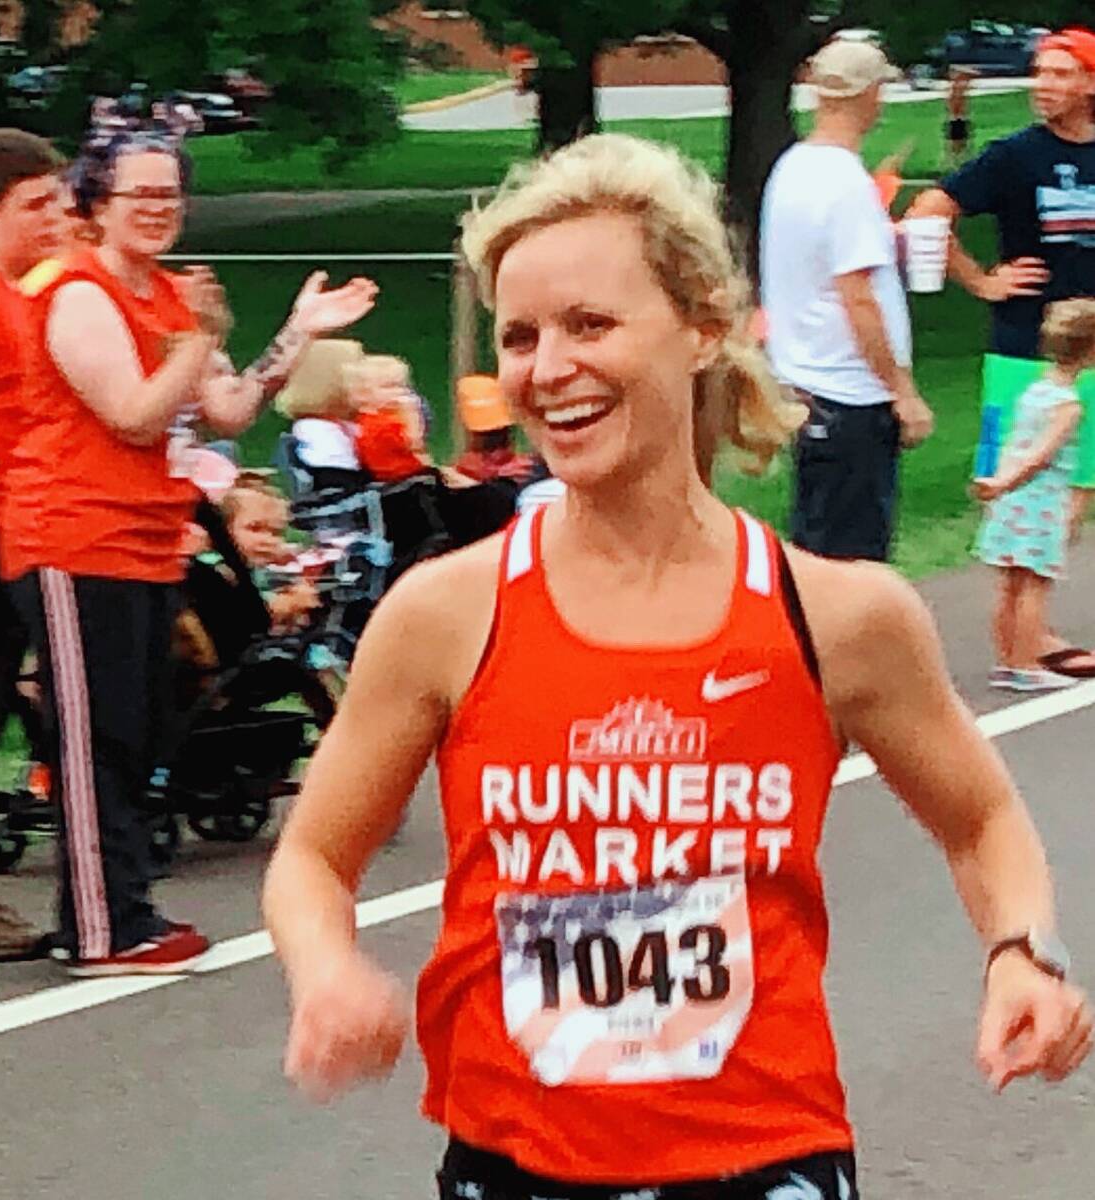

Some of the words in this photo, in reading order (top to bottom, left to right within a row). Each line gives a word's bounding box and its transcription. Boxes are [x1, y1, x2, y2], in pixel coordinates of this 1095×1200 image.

[482, 763, 793, 822] RUNNERS
[489, 827, 793, 884] MARKET
[534, 925, 732, 1010] 1043
